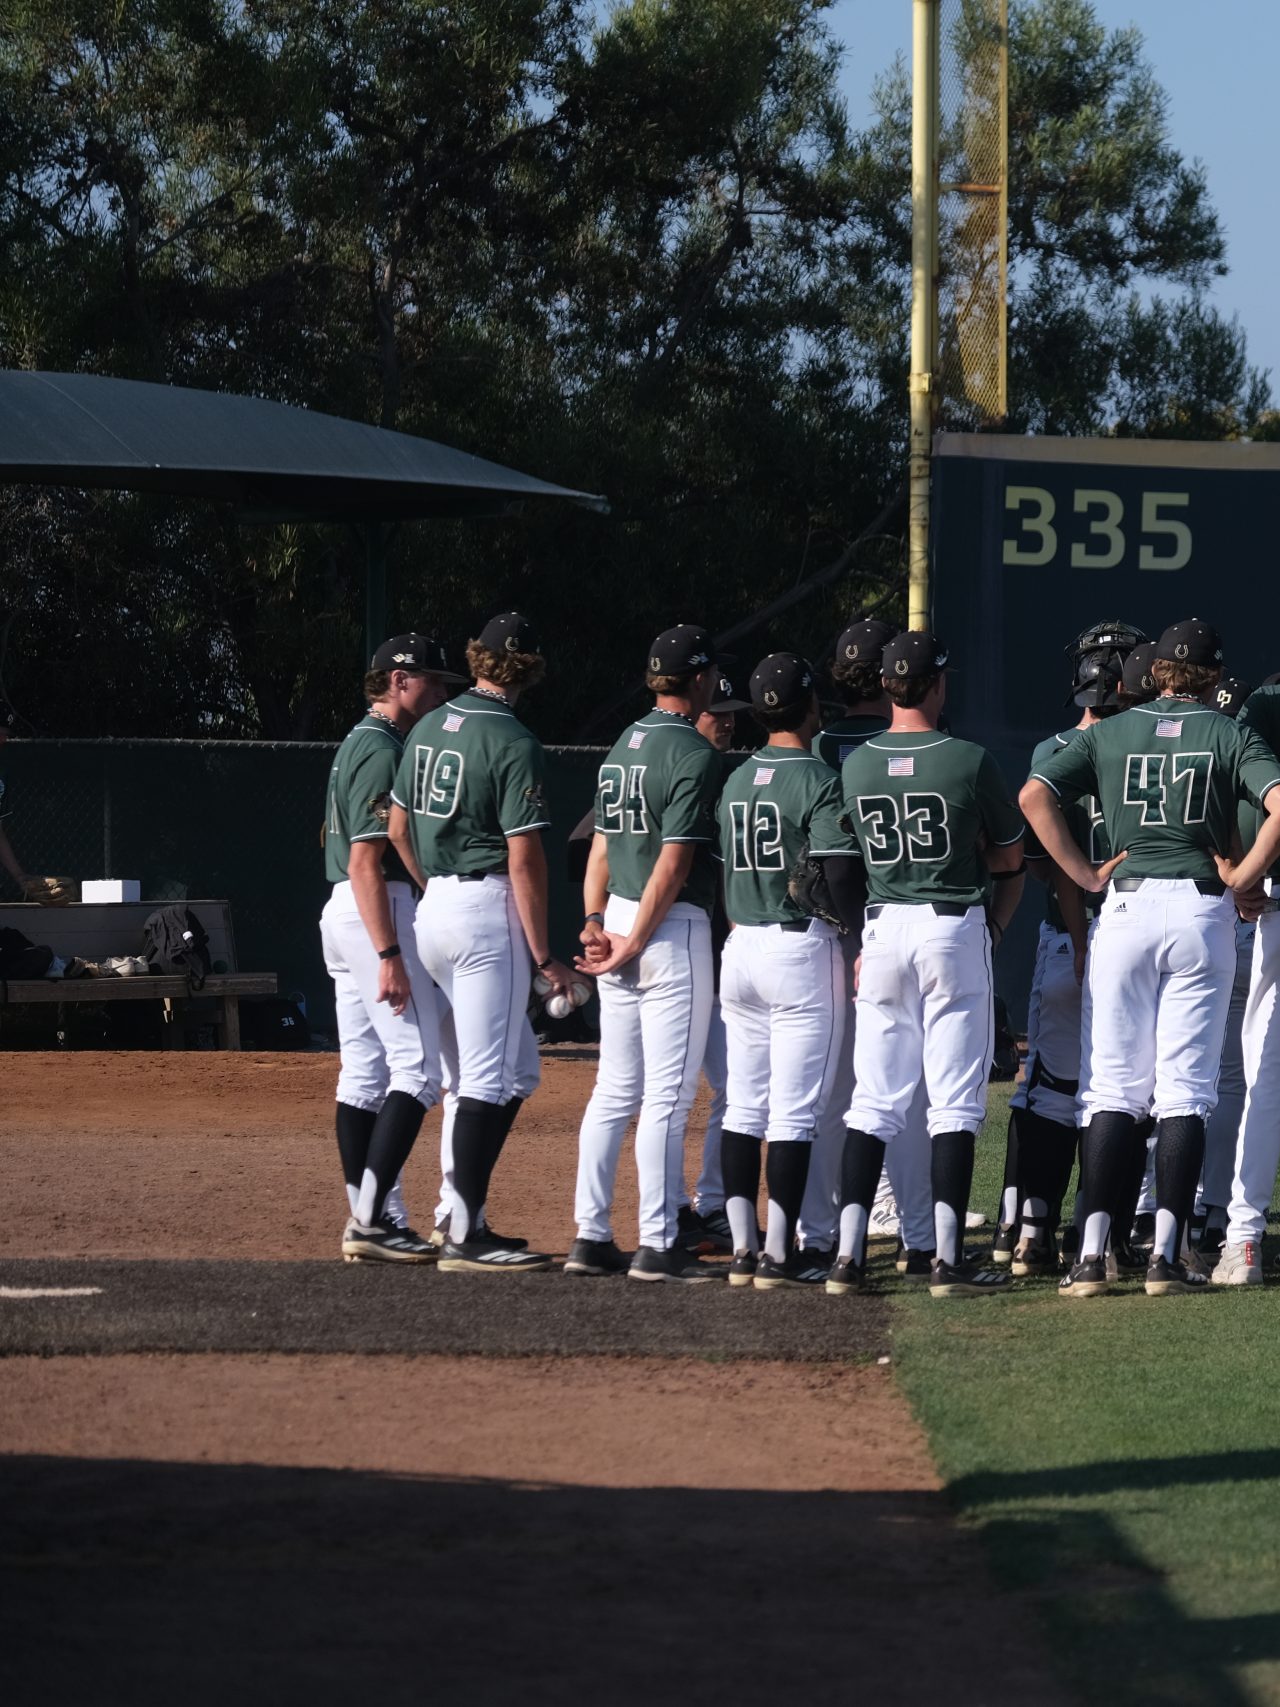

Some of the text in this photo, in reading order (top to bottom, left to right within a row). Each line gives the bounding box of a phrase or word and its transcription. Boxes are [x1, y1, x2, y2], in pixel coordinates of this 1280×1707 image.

[1003, 485, 1193, 571] 335
[413, 745, 464, 819] 19
[598, 764, 650, 834] 24
[1123, 752, 1215, 826] 47
[729, 801, 786, 872] 12
[857, 792, 953, 865] 33
